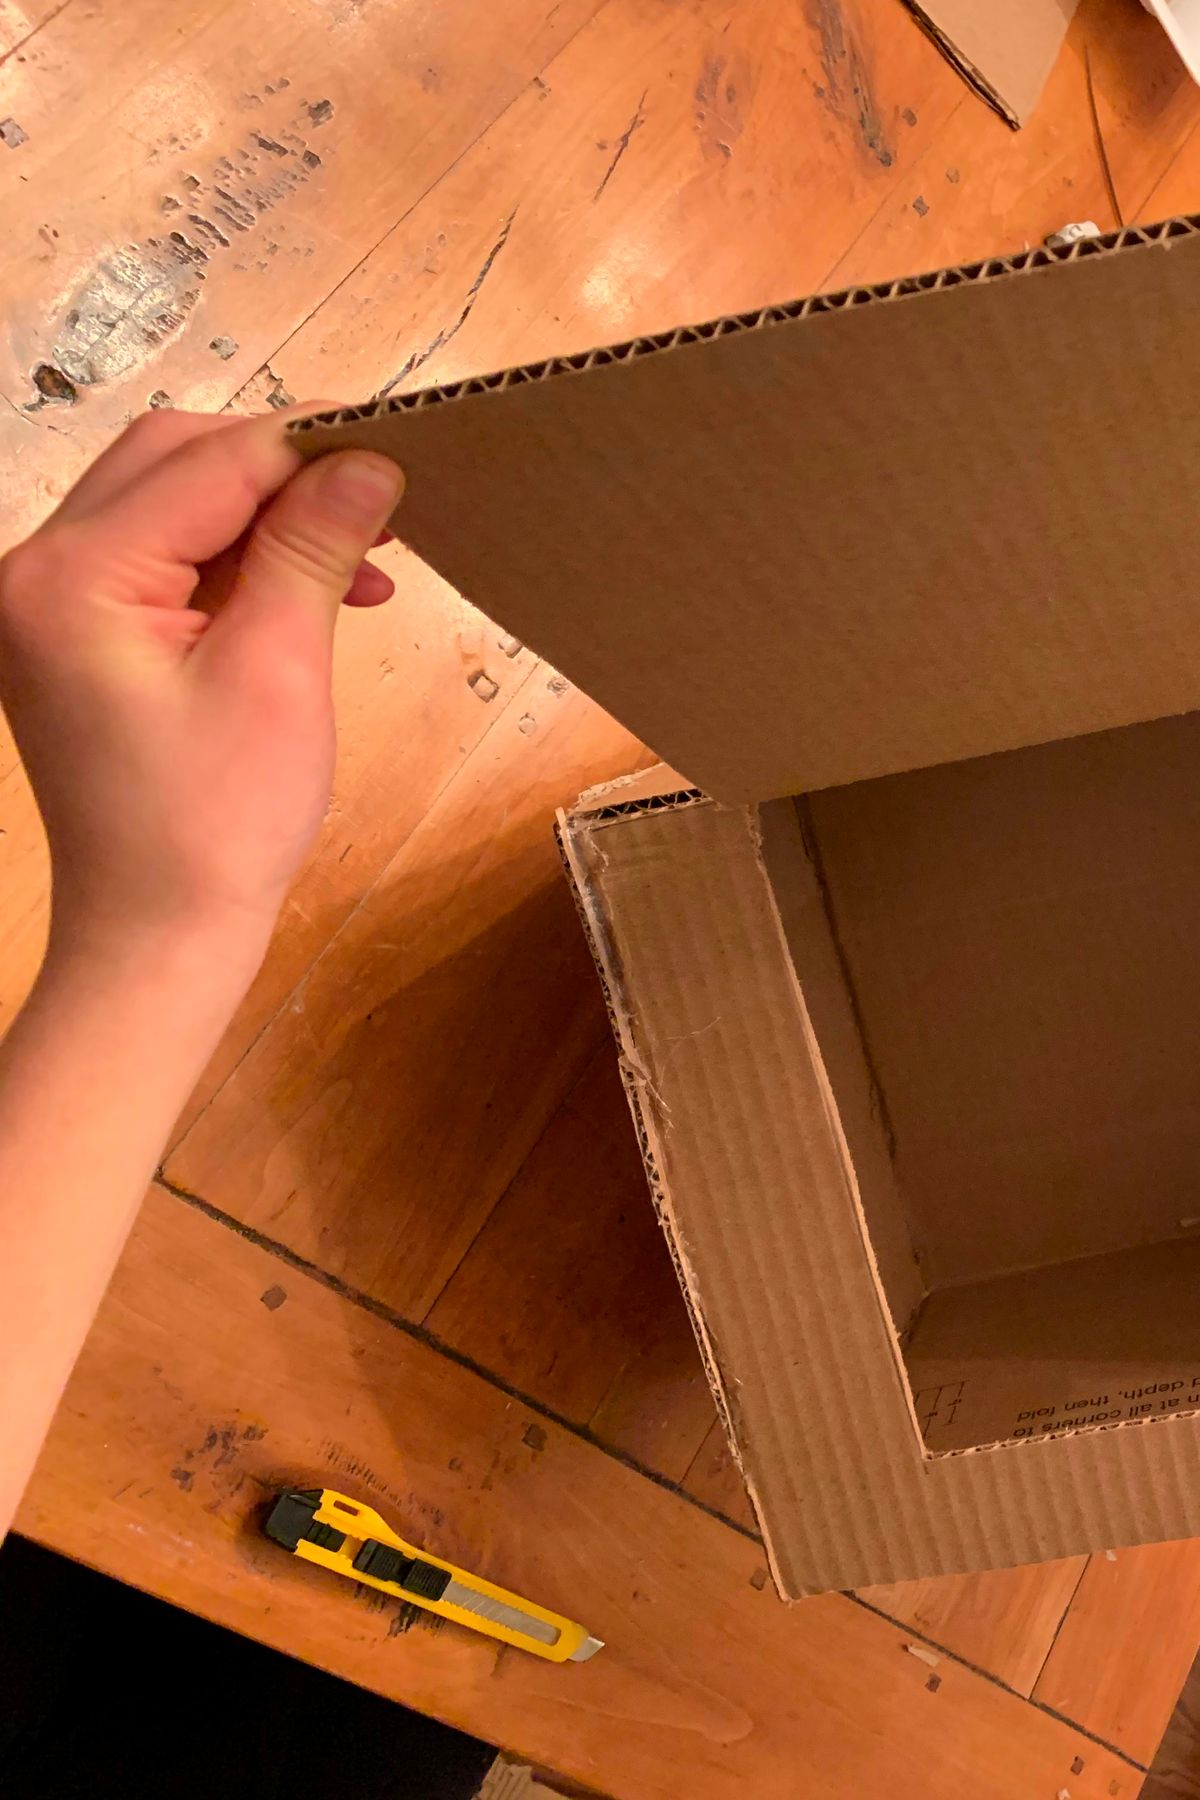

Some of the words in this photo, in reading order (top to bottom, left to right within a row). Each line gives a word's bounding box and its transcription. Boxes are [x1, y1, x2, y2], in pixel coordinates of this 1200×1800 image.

[1118, 1379, 1185, 1400] depth,
[1064, 1394, 1109, 1411] then
[1128, 1402, 1153, 1418] all
[1159, 1397, 1180, 1411] at
[1016, 1405, 1056, 1423] fold
[1042, 1408, 1122, 1433] corners
[1013, 1427, 1034, 1438] to
